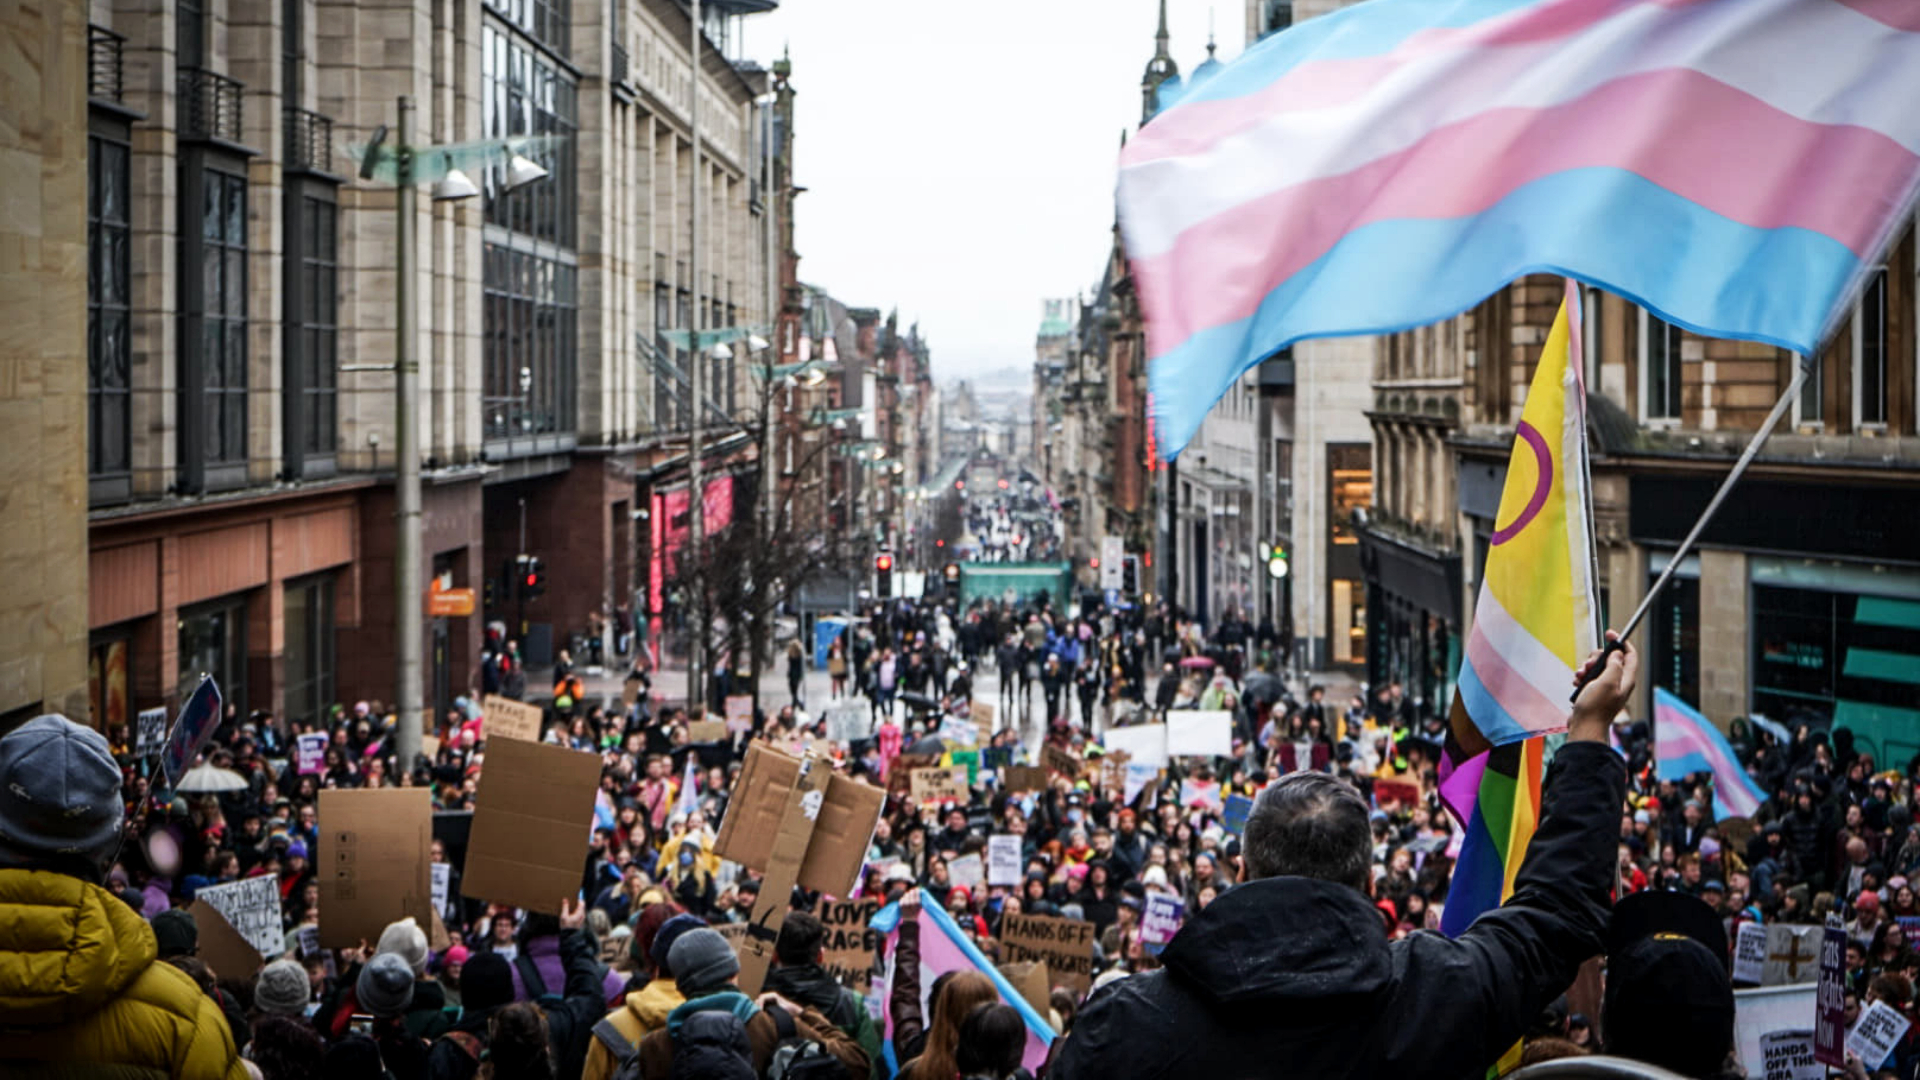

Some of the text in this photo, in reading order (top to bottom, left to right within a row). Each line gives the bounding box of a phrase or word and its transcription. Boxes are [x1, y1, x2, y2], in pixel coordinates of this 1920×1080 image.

[821, 901, 878, 927] LOVE
[821, 928, 876, 952] RAGE
[1006, 918, 1094, 945] HANDS OFF
[1824, 940, 1840, 970] ans
[1765, 1042, 1808, 1059] HANDS
[1766, 1054, 1816, 1071] OFF THE
